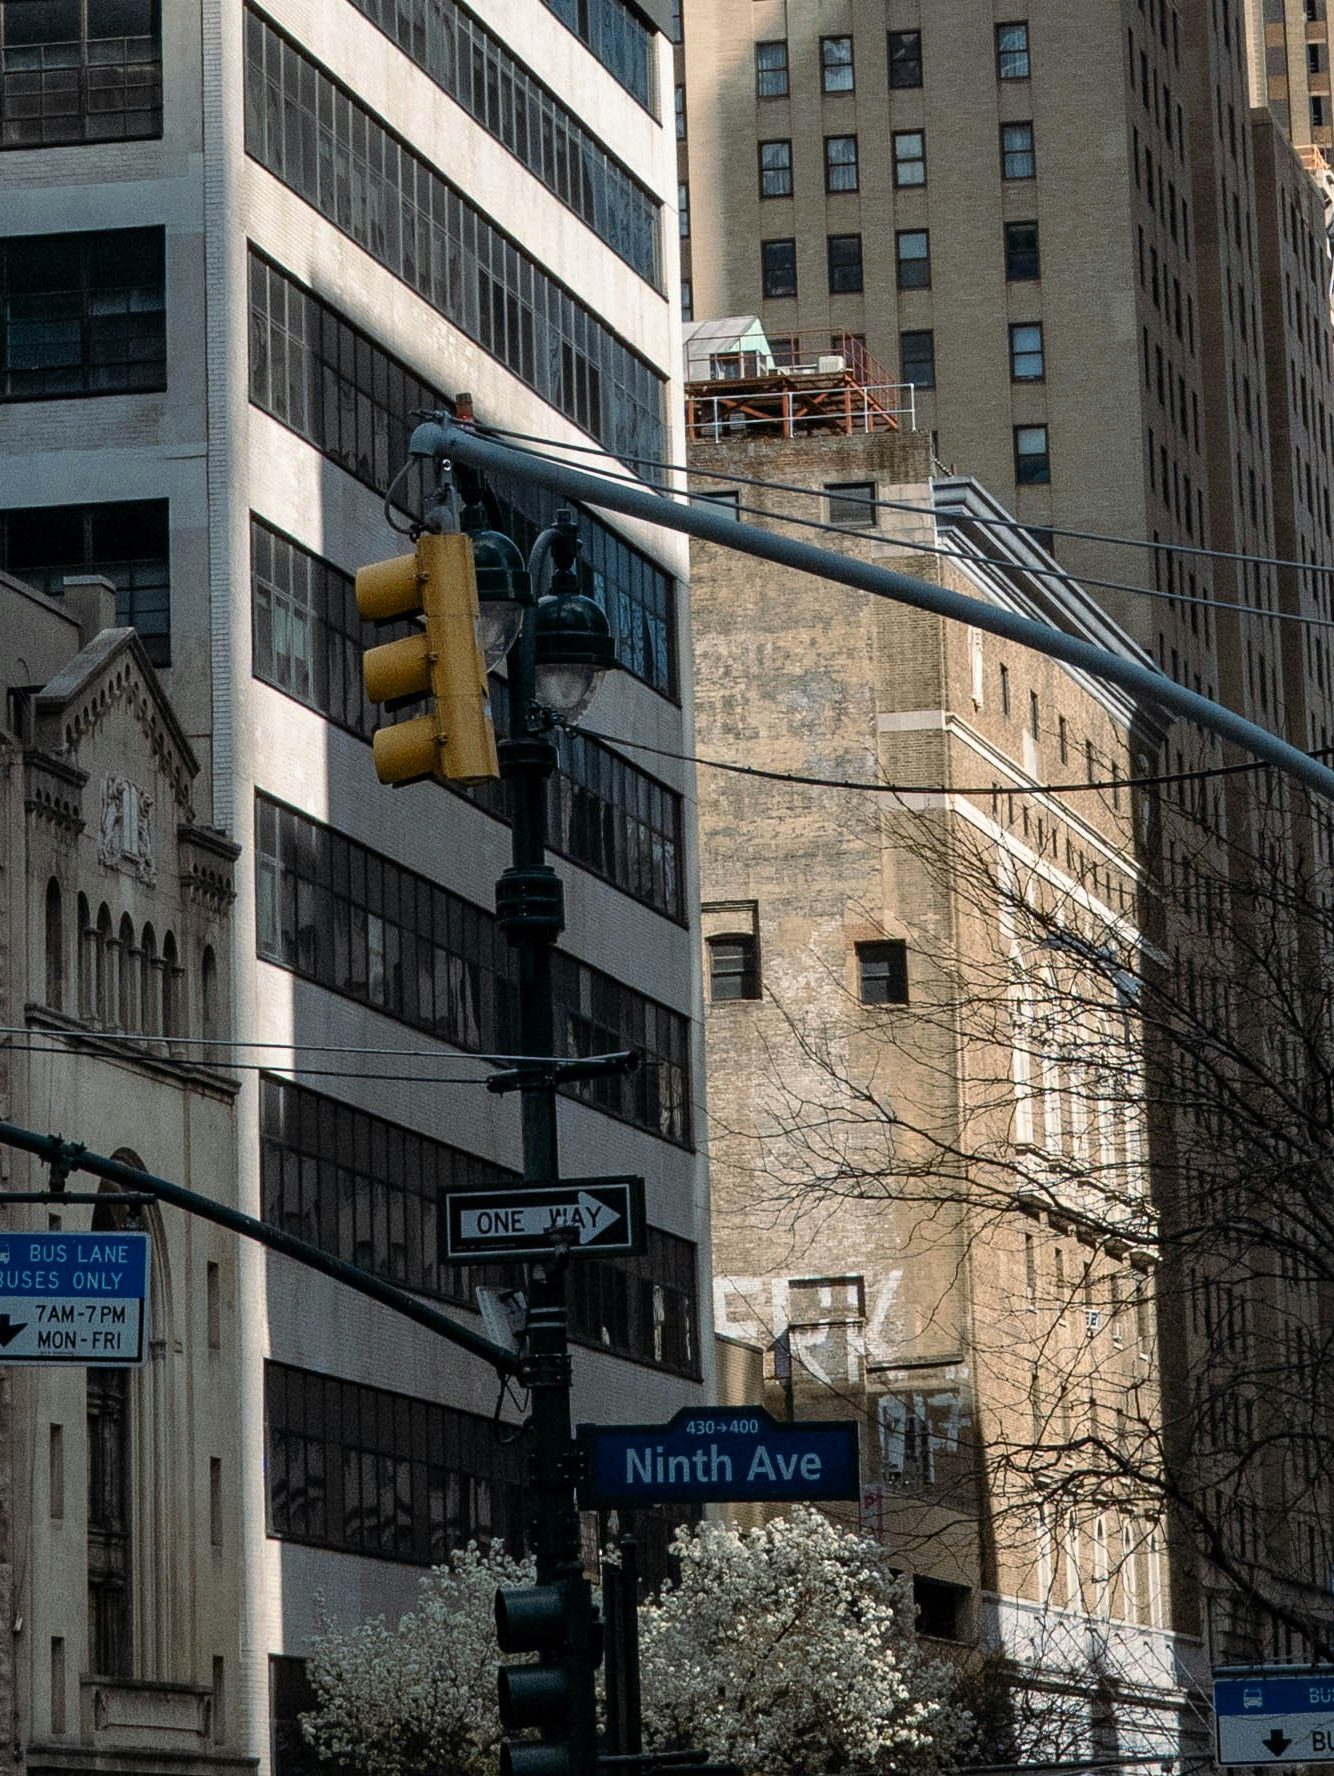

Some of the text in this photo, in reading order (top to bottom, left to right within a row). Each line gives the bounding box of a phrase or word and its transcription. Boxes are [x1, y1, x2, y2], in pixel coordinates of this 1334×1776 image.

[476, 1205, 604, 1235] ONE WAY
[29, 1243, 130, 1265] BUS LANE
[72, 1271, 124, 1291] ONLY
[625, 1443, 824, 1485] Ninth Ave
